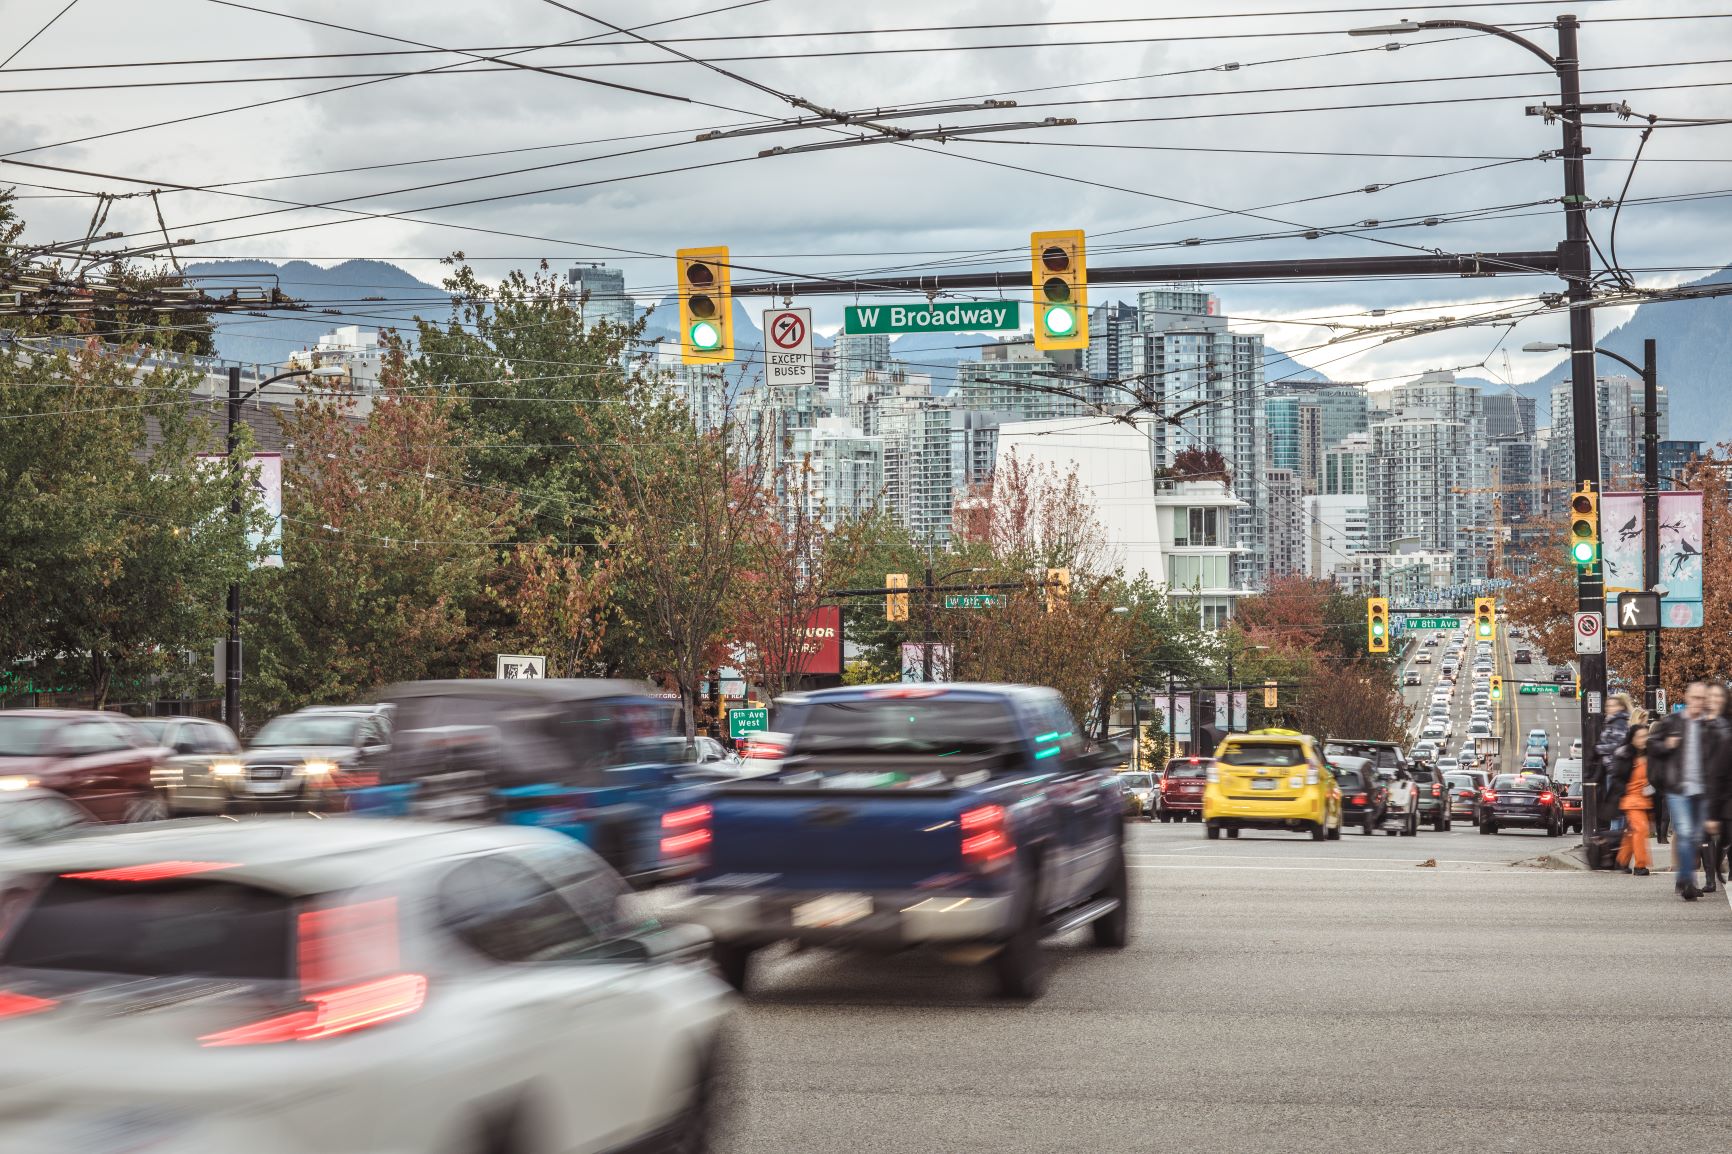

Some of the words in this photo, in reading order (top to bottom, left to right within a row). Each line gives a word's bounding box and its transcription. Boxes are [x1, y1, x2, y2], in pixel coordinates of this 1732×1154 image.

[857, 308, 880, 328] W
[890, 306, 1007, 327] Broadway
[772, 354, 807, 364] EXCEPT
[774, 366, 806, 376] BUSES
[1409, 620, 1417, 628] W
[1421, 620, 1437, 628] 8th
[1440, 620, 1457, 628] Ave
[749, 711, 764, 719] Ave
